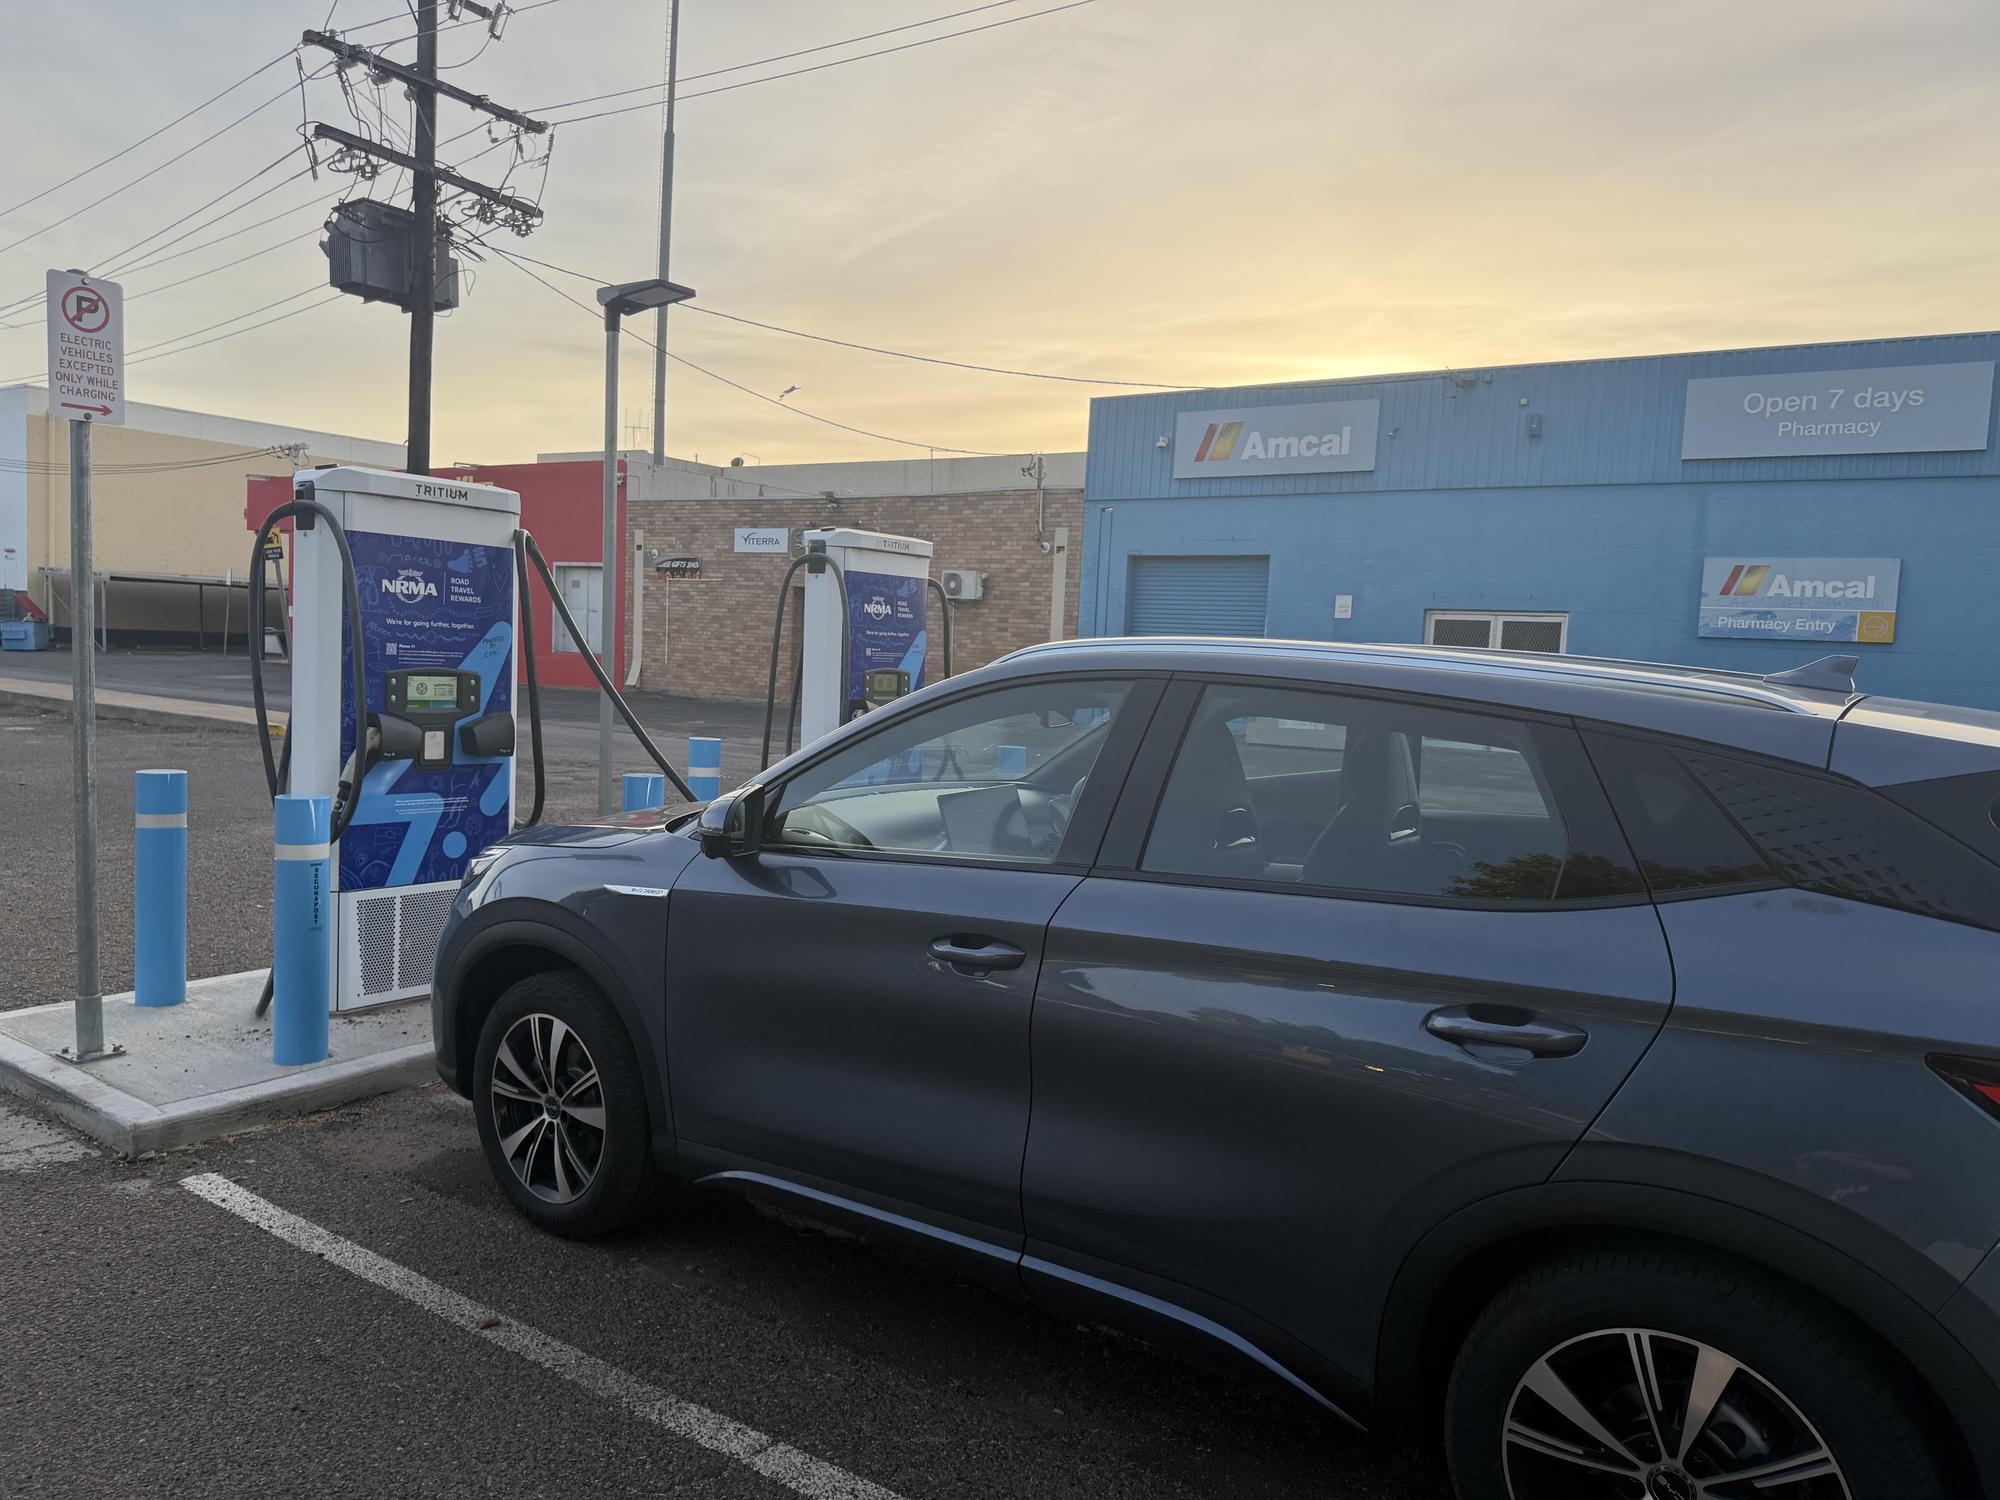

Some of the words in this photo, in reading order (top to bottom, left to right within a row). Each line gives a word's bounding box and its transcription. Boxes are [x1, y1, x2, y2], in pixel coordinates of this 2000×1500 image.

[60, 333, 112, 350] ELECTRIC
[60, 347, 113, 363] VEHICLES
[59, 359, 114, 376] EXCEPTED
[55, 371, 83, 384] ONLY
[87, 375, 119, 390] WHILE
[59, 385, 116, 401] CHARGING
[1743, 392, 1817, 417] Open
[1828, 389, 1845, 410] 7
[1853, 386, 1925, 413] days
[1777, 420, 1881, 438] Pharmacy
[1240, 426, 1351, 461] Amcal
[415, 484, 468, 501] TRITIUM
[883, 540, 911, 552] TRITIUM
[381, 579, 438, 597] NRMA
[450, 577, 470, 586] ROAD
[1766, 574, 1876, 599] Amcal
[450, 586, 475, 595] TRAVEL
[450, 595, 482, 604] REWARDS
[863, 603, 892, 615] NRMA
[385, 617, 403, 626] We're
[403, 618, 412, 626] for
[413, 619, 430, 629] going
[430, 620, 451, 629] further,
[1718, 616, 1792, 633] Pharmacy
[1795, 618, 1836, 634] Entry
